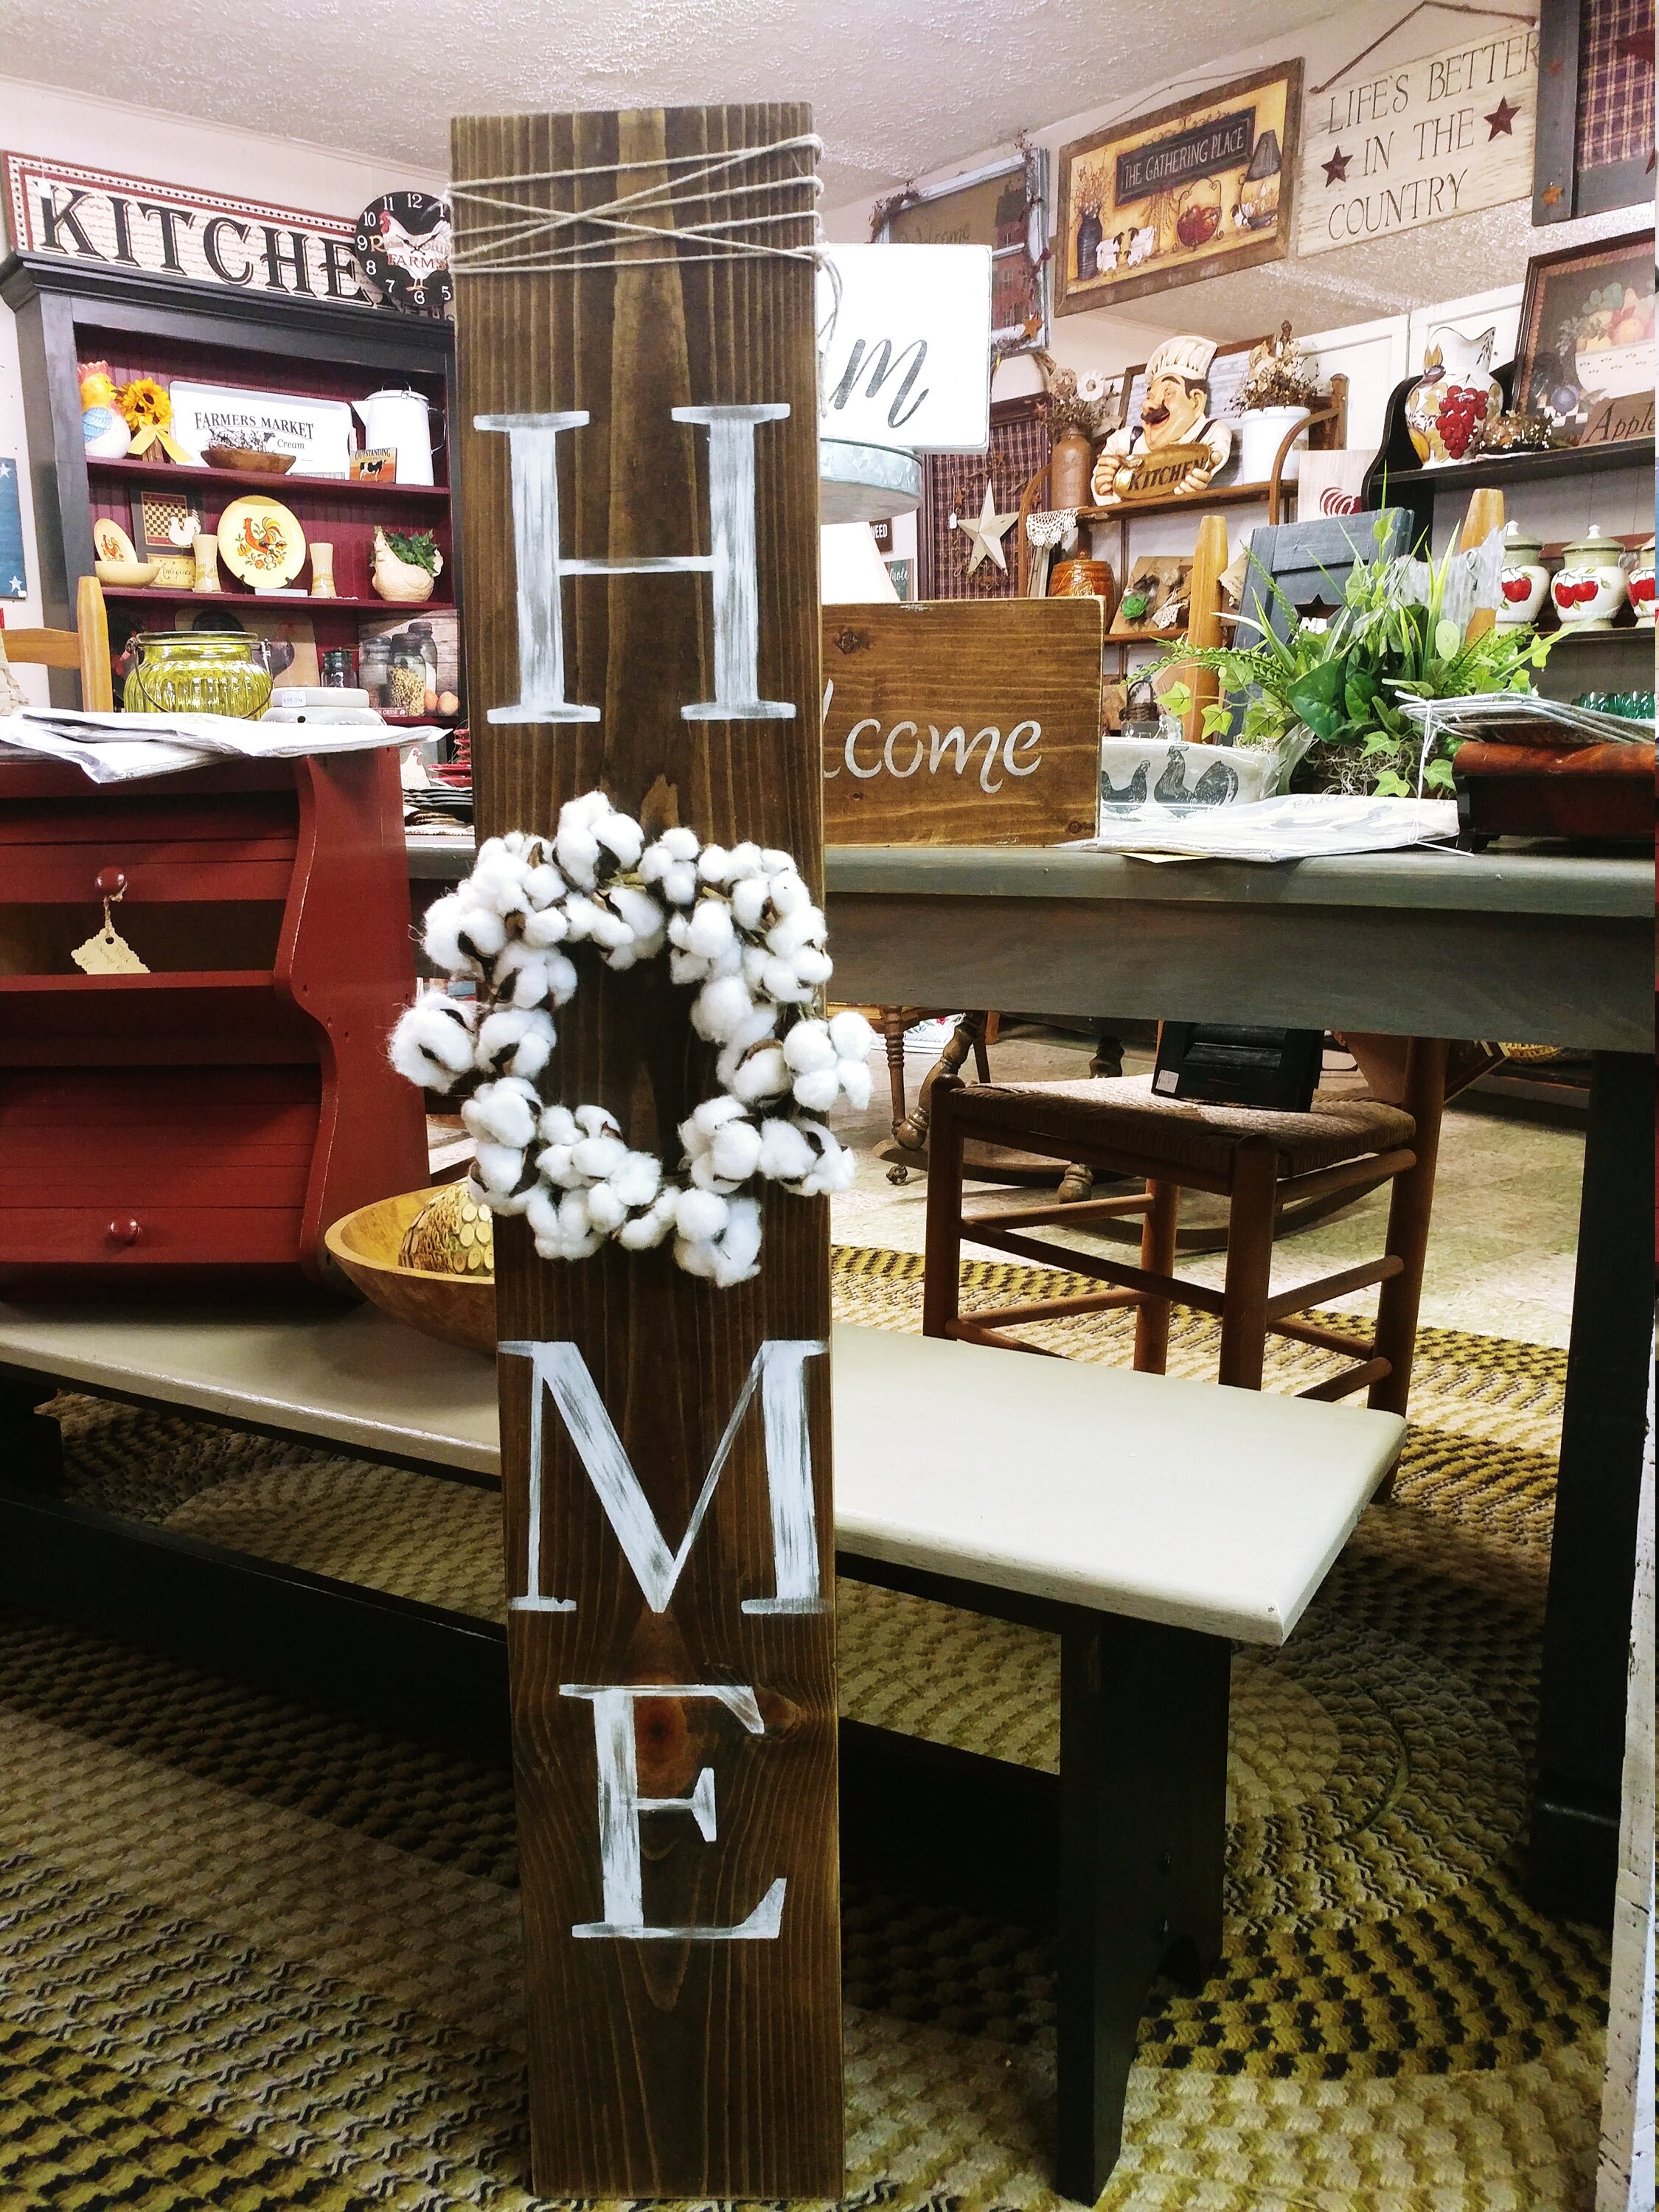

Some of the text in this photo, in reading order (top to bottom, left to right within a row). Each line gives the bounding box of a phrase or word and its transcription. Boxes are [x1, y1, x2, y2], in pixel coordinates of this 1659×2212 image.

[1328, 31, 1540, 135] LIFE'S BETTER
[1363, 108, 1475, 176] IN THE
[1124, 127, 1245, 189] THE GATHERING PLACE
[383, 195, 394, 212] 11
[407, 192, 423, 209] 12
[1328, 168, 1469, 240] COUNTRY
[364, 211, 377, 227] 10
[33, 180, 399, 309] KITCHE
[357, 234, 369, 251] 9
[366, 260, 377, 275] 8
[387, 254, 448, 271] FARMS
[385, 279, 396, 293] 7
[441, 285, 452, 301] 5
[414, 291, 425, 305] 6
[194, 411, 314, 439] FARMERS MARKET
[277, 439, 305, 450] Cream
[355, 448, 391, 460] OUTSTANDING
[1127, 458, 1205, 491] KITCHEN
